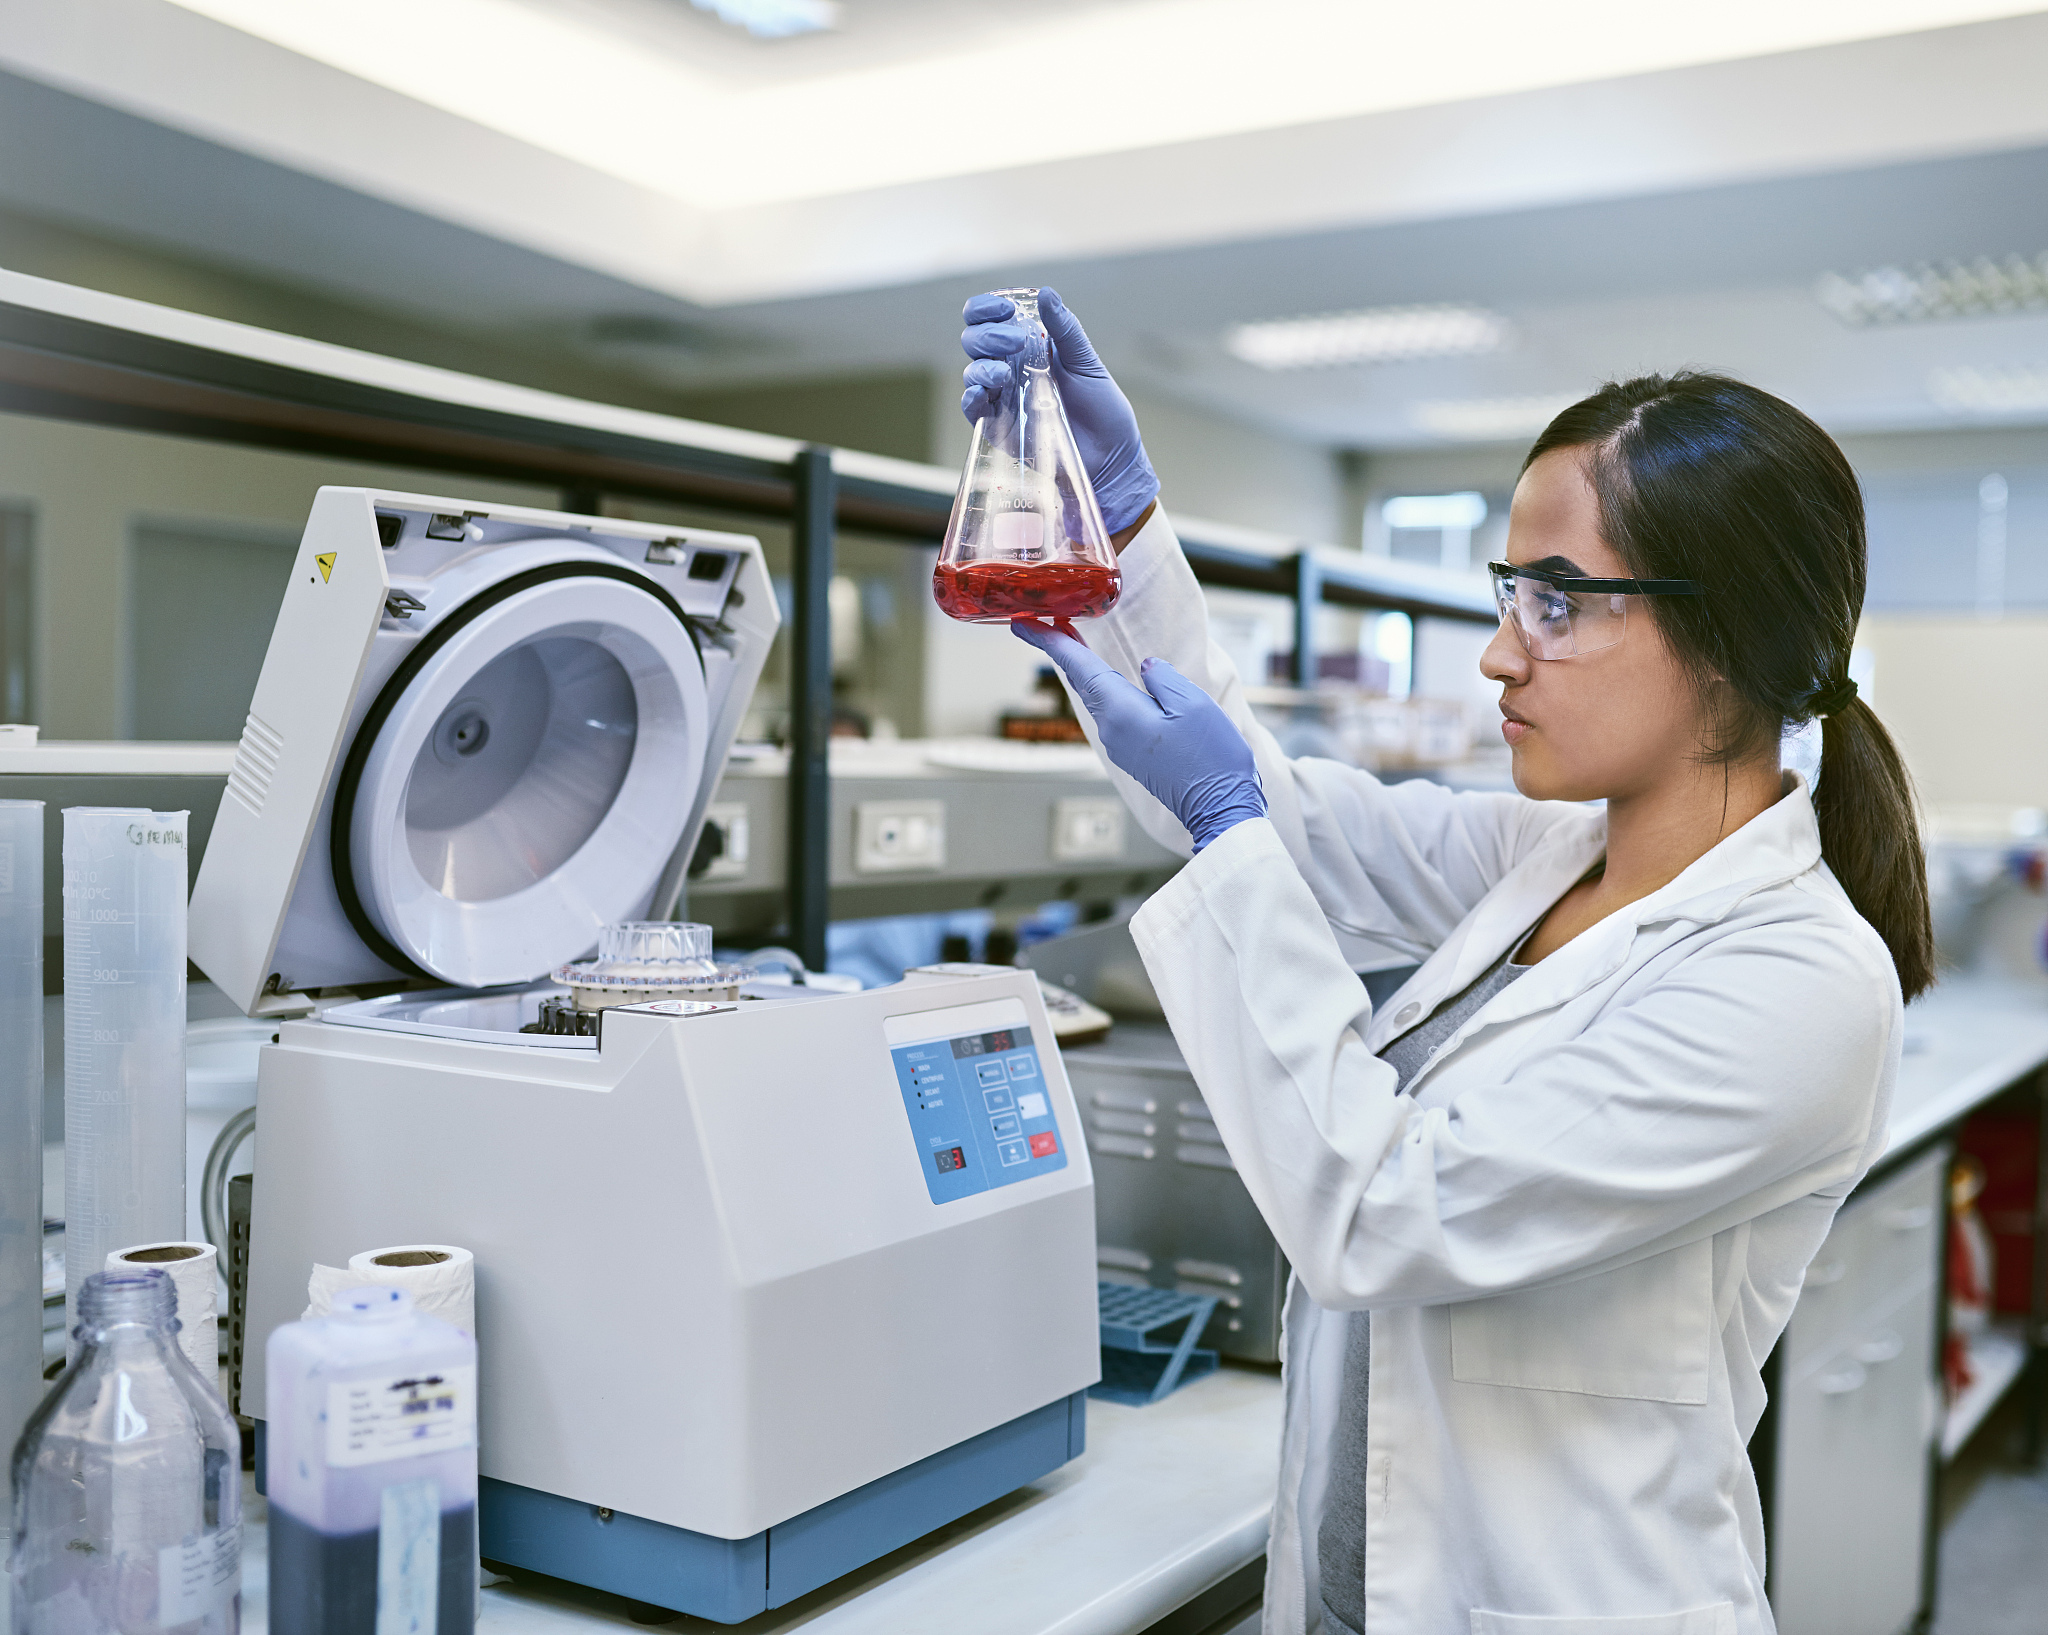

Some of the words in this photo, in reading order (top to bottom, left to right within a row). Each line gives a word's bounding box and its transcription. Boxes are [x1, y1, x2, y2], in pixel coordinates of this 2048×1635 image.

[90, 908, 119, 921] 1000
[93, 969, 119, 982] 900
[93, 1029, 119, 1042] 800
[94, 1090, 119, 1103] 700
[951, 1149, 962, 1170] 3
